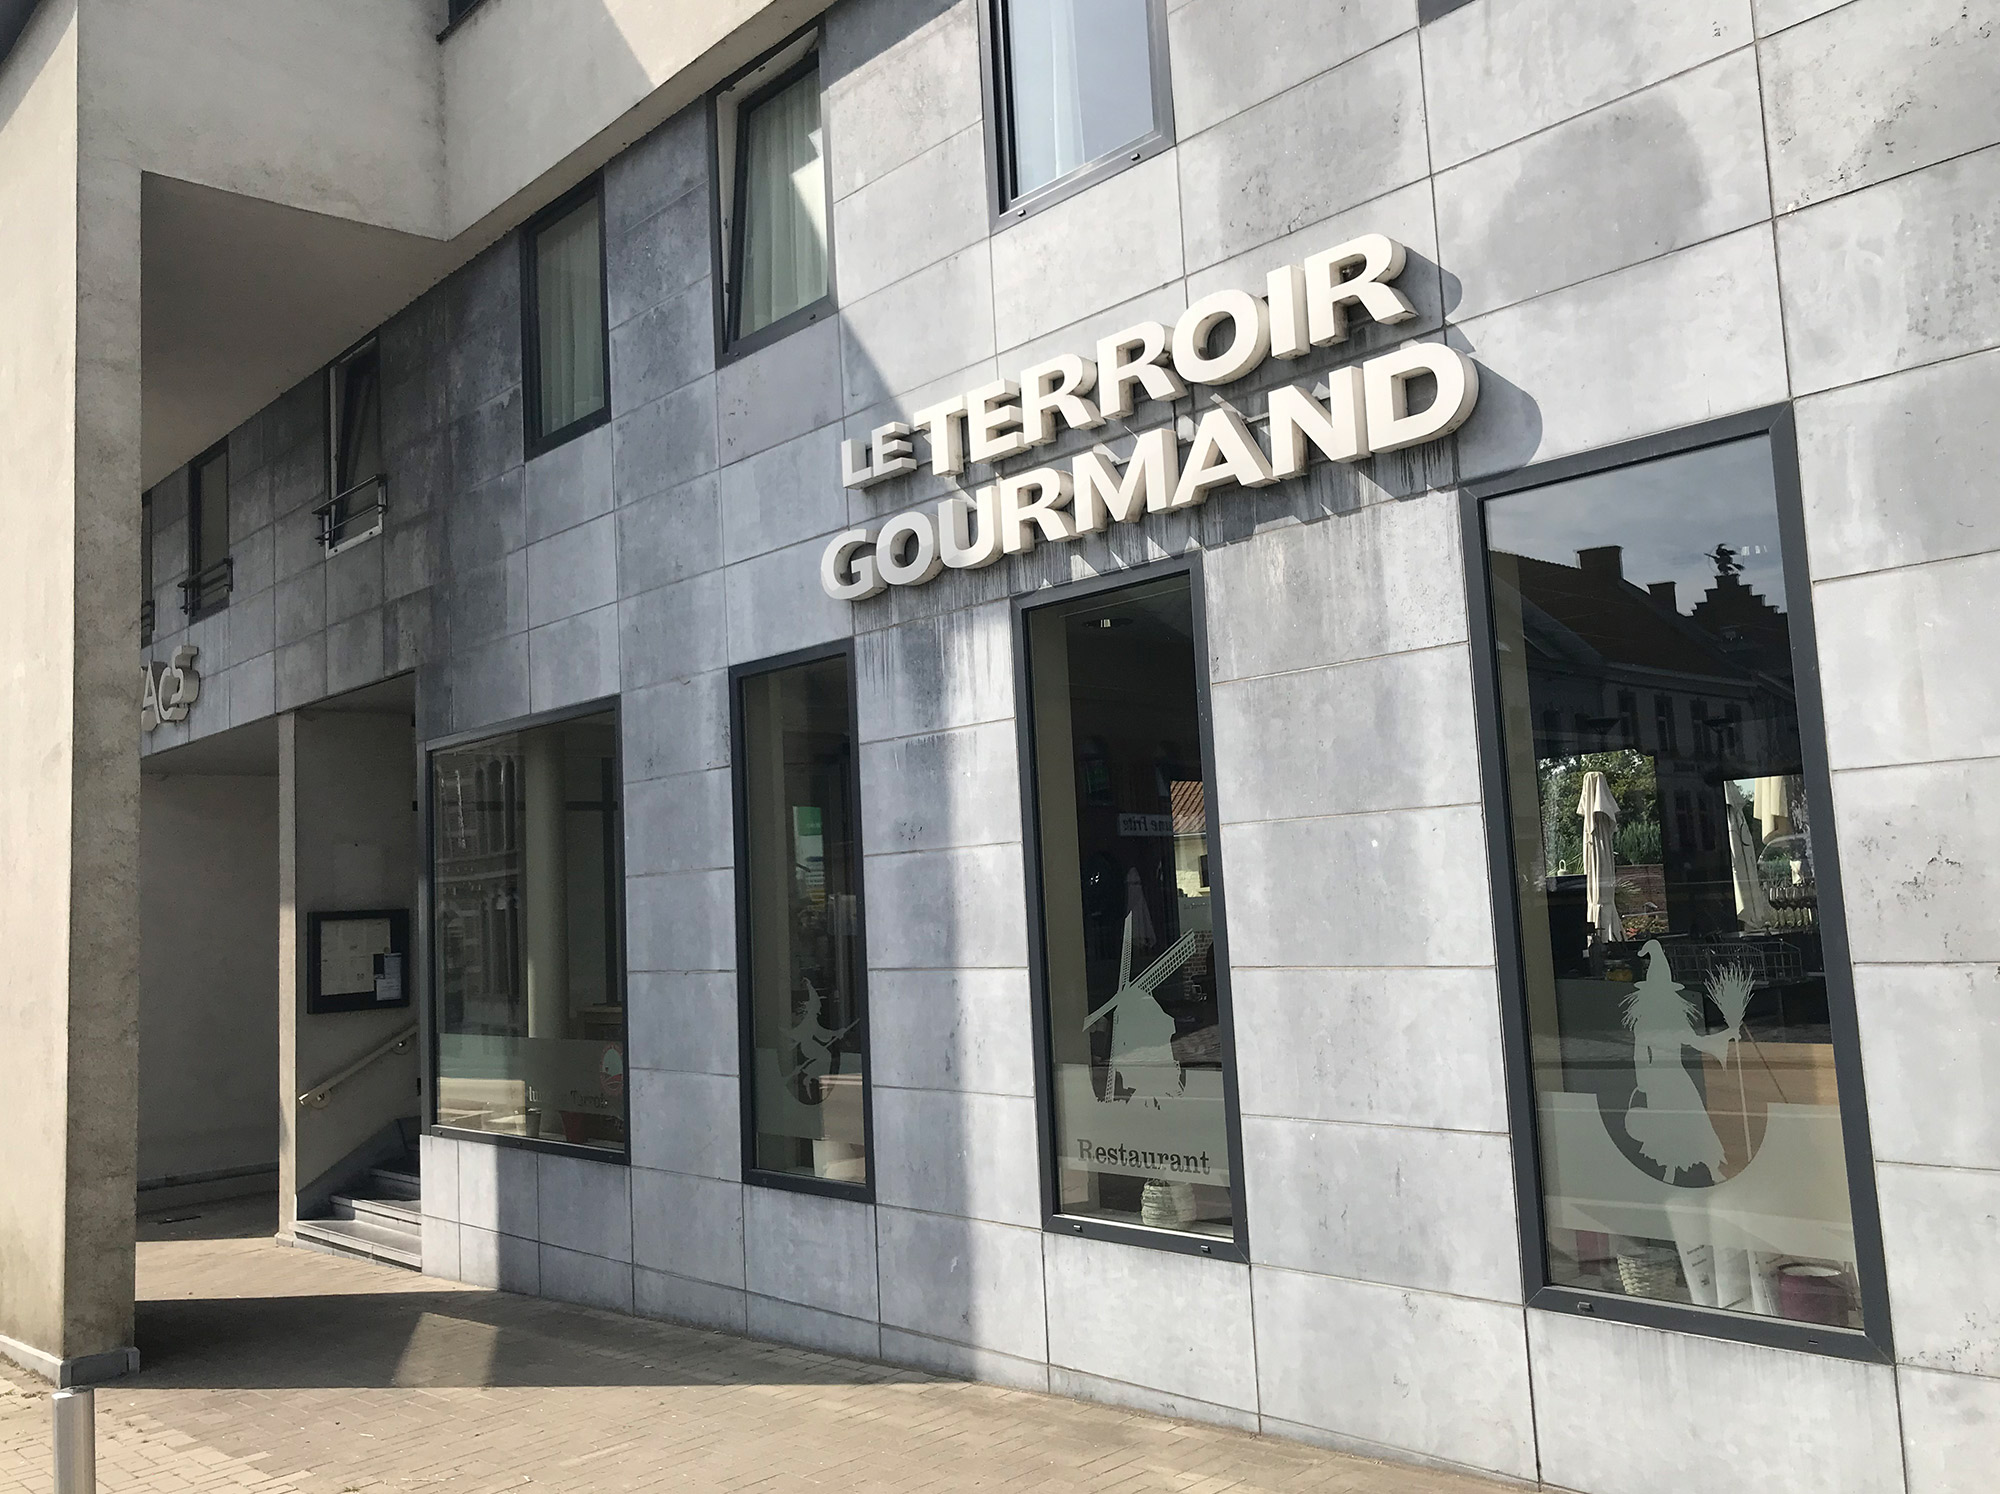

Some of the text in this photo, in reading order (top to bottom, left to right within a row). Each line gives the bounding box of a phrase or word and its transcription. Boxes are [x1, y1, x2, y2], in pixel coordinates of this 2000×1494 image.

[821, 341, 1479, 602] GOURMAND
[842, 233, 1418, 490] LE TERROIR
[1076, 1138, 1211, 1176] Restaurant
